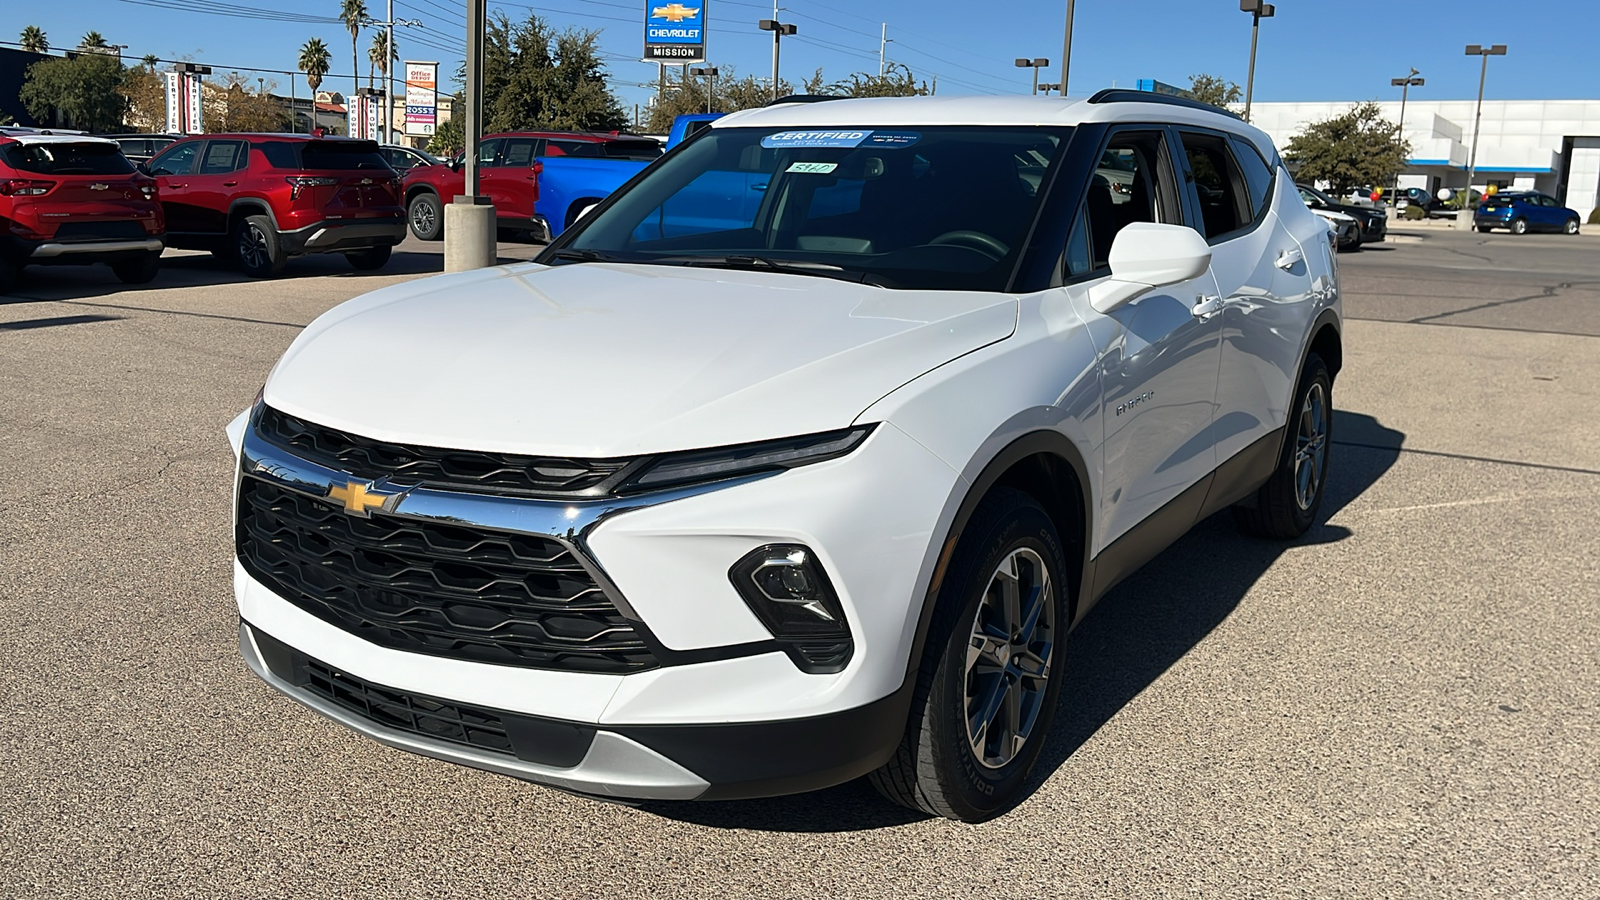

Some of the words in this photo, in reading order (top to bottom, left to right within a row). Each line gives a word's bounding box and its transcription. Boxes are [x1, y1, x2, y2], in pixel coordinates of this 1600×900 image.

[649, 29, 700, 38] CHEVROLET
[653, 48, 695, 57] MISSION
[407, 106, 428, 114] ROSS
[770, 131, 864, 141] CERTIFIED
